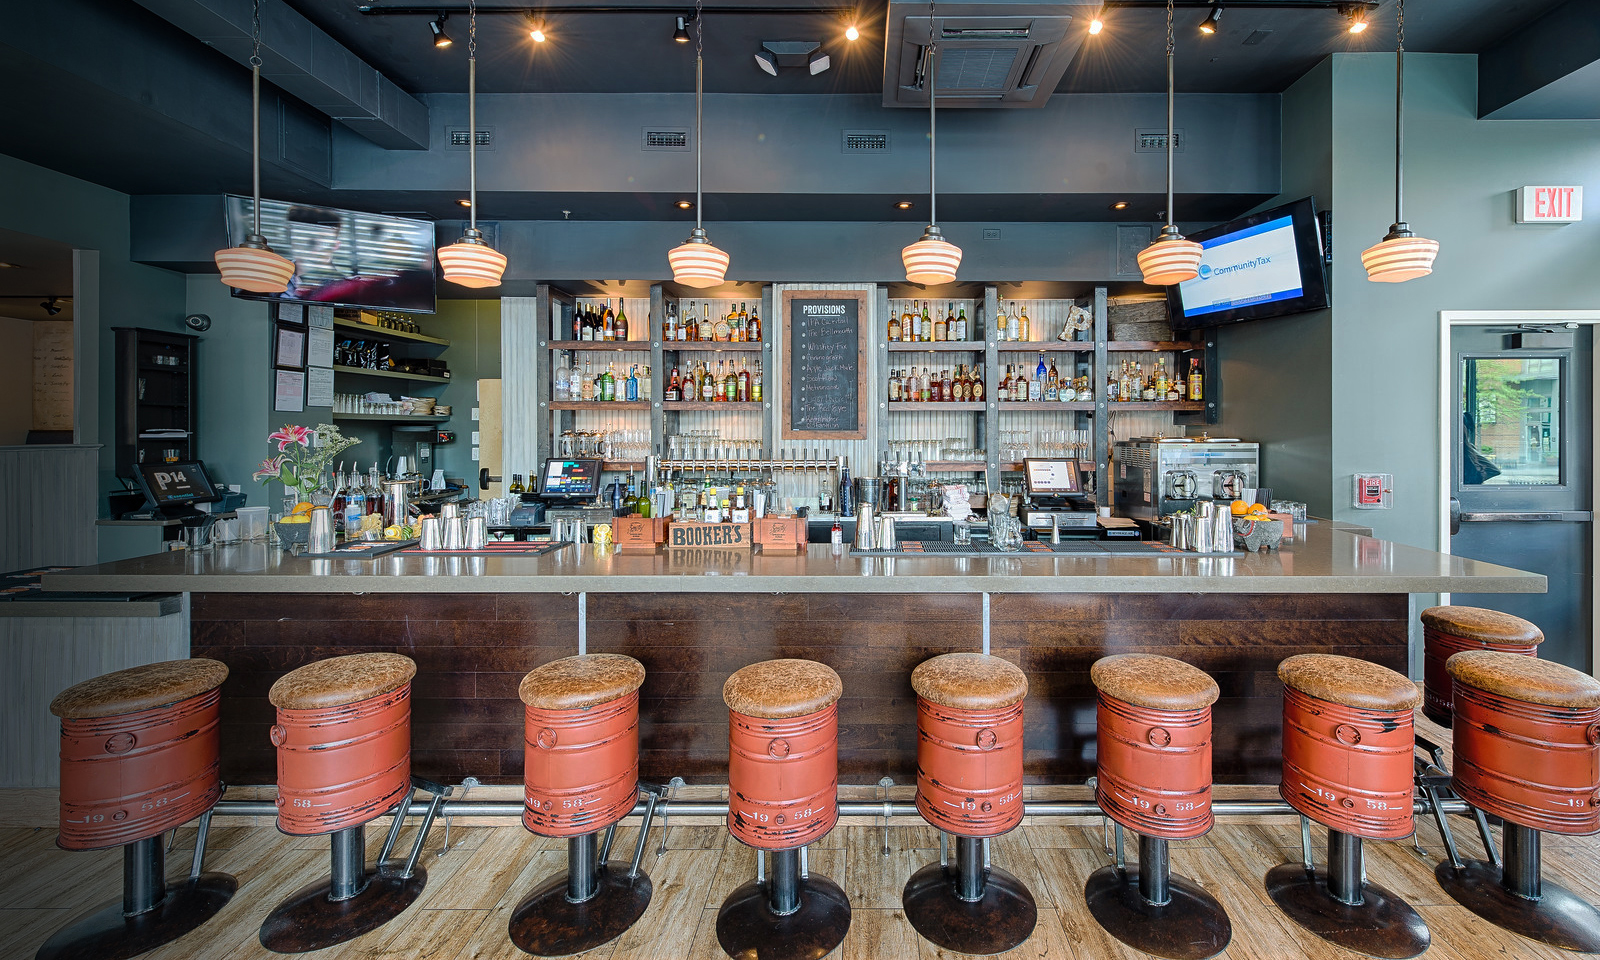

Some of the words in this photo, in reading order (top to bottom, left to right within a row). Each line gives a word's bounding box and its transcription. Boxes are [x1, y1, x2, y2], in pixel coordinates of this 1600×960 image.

[1535, 187, 1574, 218] EXIT
[803, 305, 846, 315] PROVISIONS
[153, 471, 187, 490] P14
[673, 525, 742, 546] BOOKER'S
[293, 798, 311, 808] 58
[528, 797, 541, 808] 19
[562, 799, 583, 808] 58
[960, 801, 976, 810] 19
[999, 794, 1014, 805] 58
[1133, 797, 1150, 808] 19
[1175, 803, 1194, 811] 58
[1316, 788, 1336, 801] 19
[1367, 800, 1387, 811] 58
[1568, 798, 1585, 808] 19
[82, 814, 104, 823] 19
[142, 797, 168, 812] 58
[752, 812, 769, 822] 19
[794, 808, 812, 819] 58
